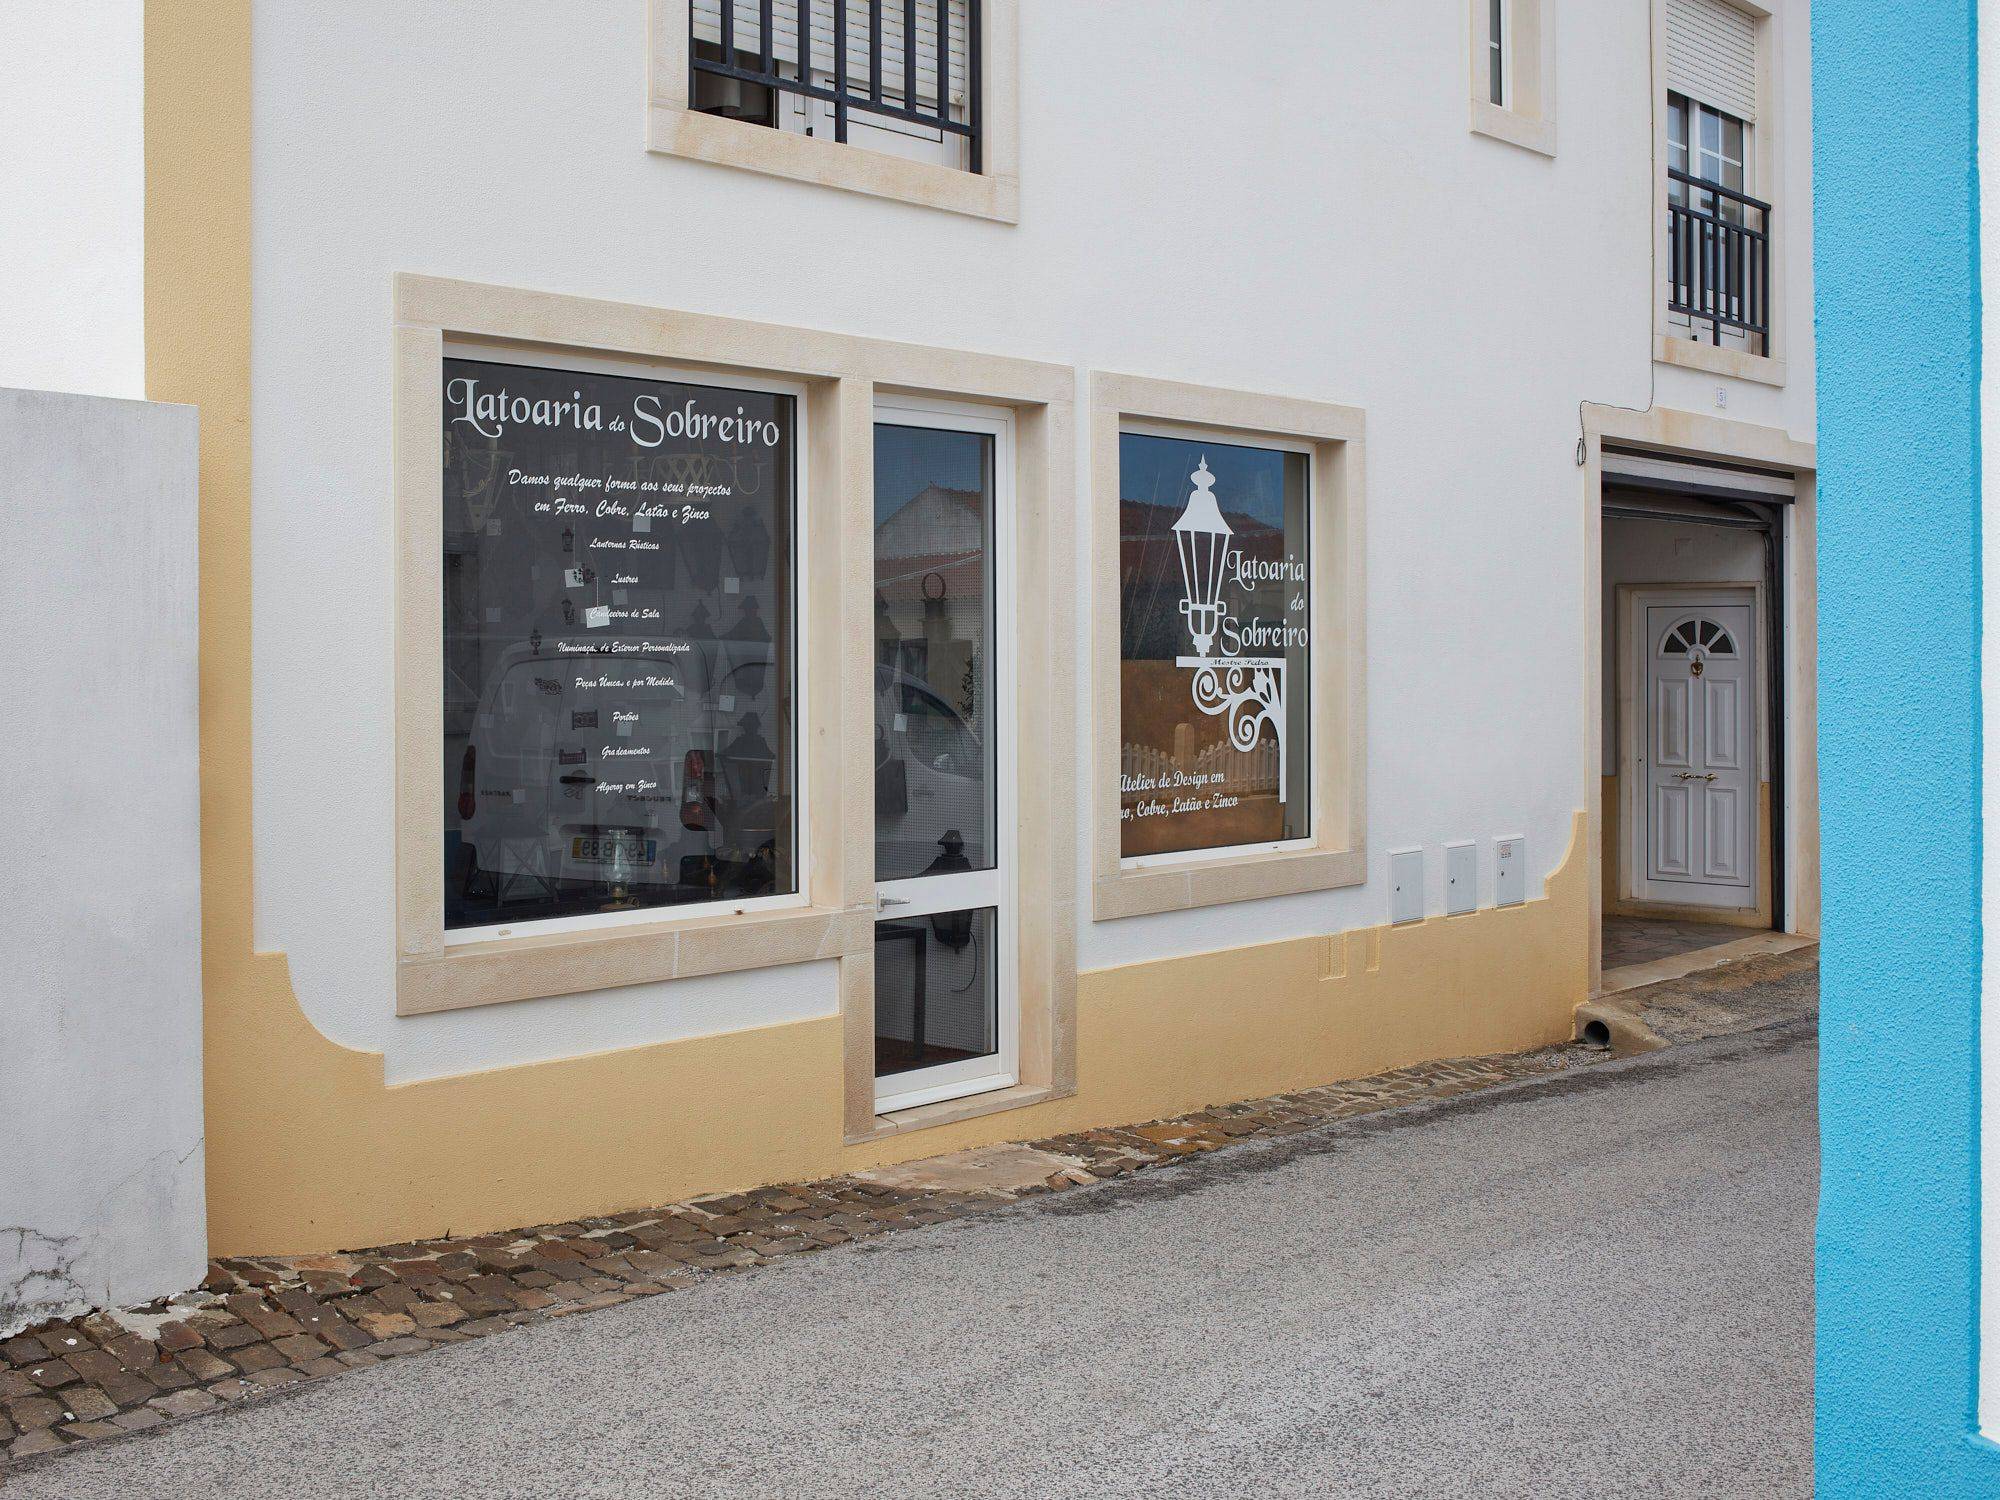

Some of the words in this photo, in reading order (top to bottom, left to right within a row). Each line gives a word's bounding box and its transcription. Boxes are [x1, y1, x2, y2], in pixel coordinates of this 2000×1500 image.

[447, 378, 603, 438] Latoaria
[608, 415, 626, 433] do
[629, 395, 780, 448] Sobreiro
[508, 469, 550, 486] Damos
[553, 474, 602, 491] qualquer
[605, 475, 637, 493] forma
[641, 480, 658, 492] aos
[662, 482, 684, 493] seus
[687, 482, 731, 499] projectos
[535, 501, 551, 512] em
[635, 501, 668, 518] Latão
[672, 508, 678, 518] e
[682, 505, 710, 524] Zinco
[589, 538, 626, 549] Lanternas
[629, 539, 660, 550] Rústicas
[611, 573, 639, 584] Lustres
[1227, 550, 1305, 591] Latoaria
[1291, 592, 1305, 611] do
[631, 608, 639, 618] de
[642, 608, 660, 618] Sala
[1220, 616, 1309, 657] Sobreiro
[600, 642, 609, 652] de
[642, 641, 690, 654] Personalizada
[575, 677, 597, 689] Peças
[632, 679, 644, 688] por
[646, 676, 674, 686] Medida
[613, 711, 639, 723] Portões
[601, 746, 650, 759] Gradeamentos
[595, 781, 623, 794] Algeroz
[637, 780, 657, 793] Zinco
[1120, 773, 1156, 792] Atelier
[1158, 772, 1171, 788] de
[1173, 770, 1208, 790] Design
[1211, 771, 1225, 783] em
[1137, 800, 1169, 817] Cobre,
[1172, 796, 1202, 813] Latão
[1205, 800, 1210, 809] e
[1213, 793, 1239, 809] Zinco
